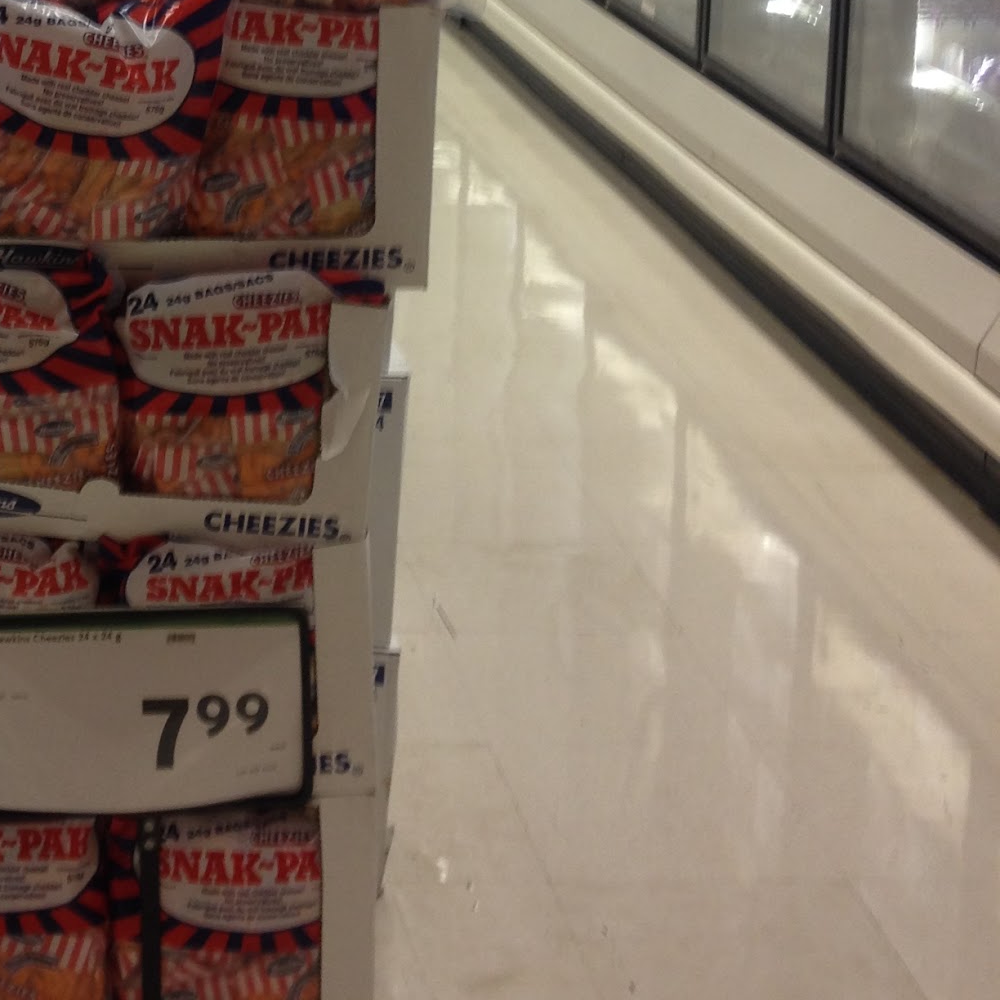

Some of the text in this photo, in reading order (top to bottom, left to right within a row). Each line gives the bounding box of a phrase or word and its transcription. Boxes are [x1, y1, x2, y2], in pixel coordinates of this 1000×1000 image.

[16, 16, 42, 28] 24g
[269, 248, 402, 270] CHEEZIES
[129, 292, 159, 316] 24
[204, 513, 340, 539] CHEEZIES
[148, 552, 178, 574] 24
